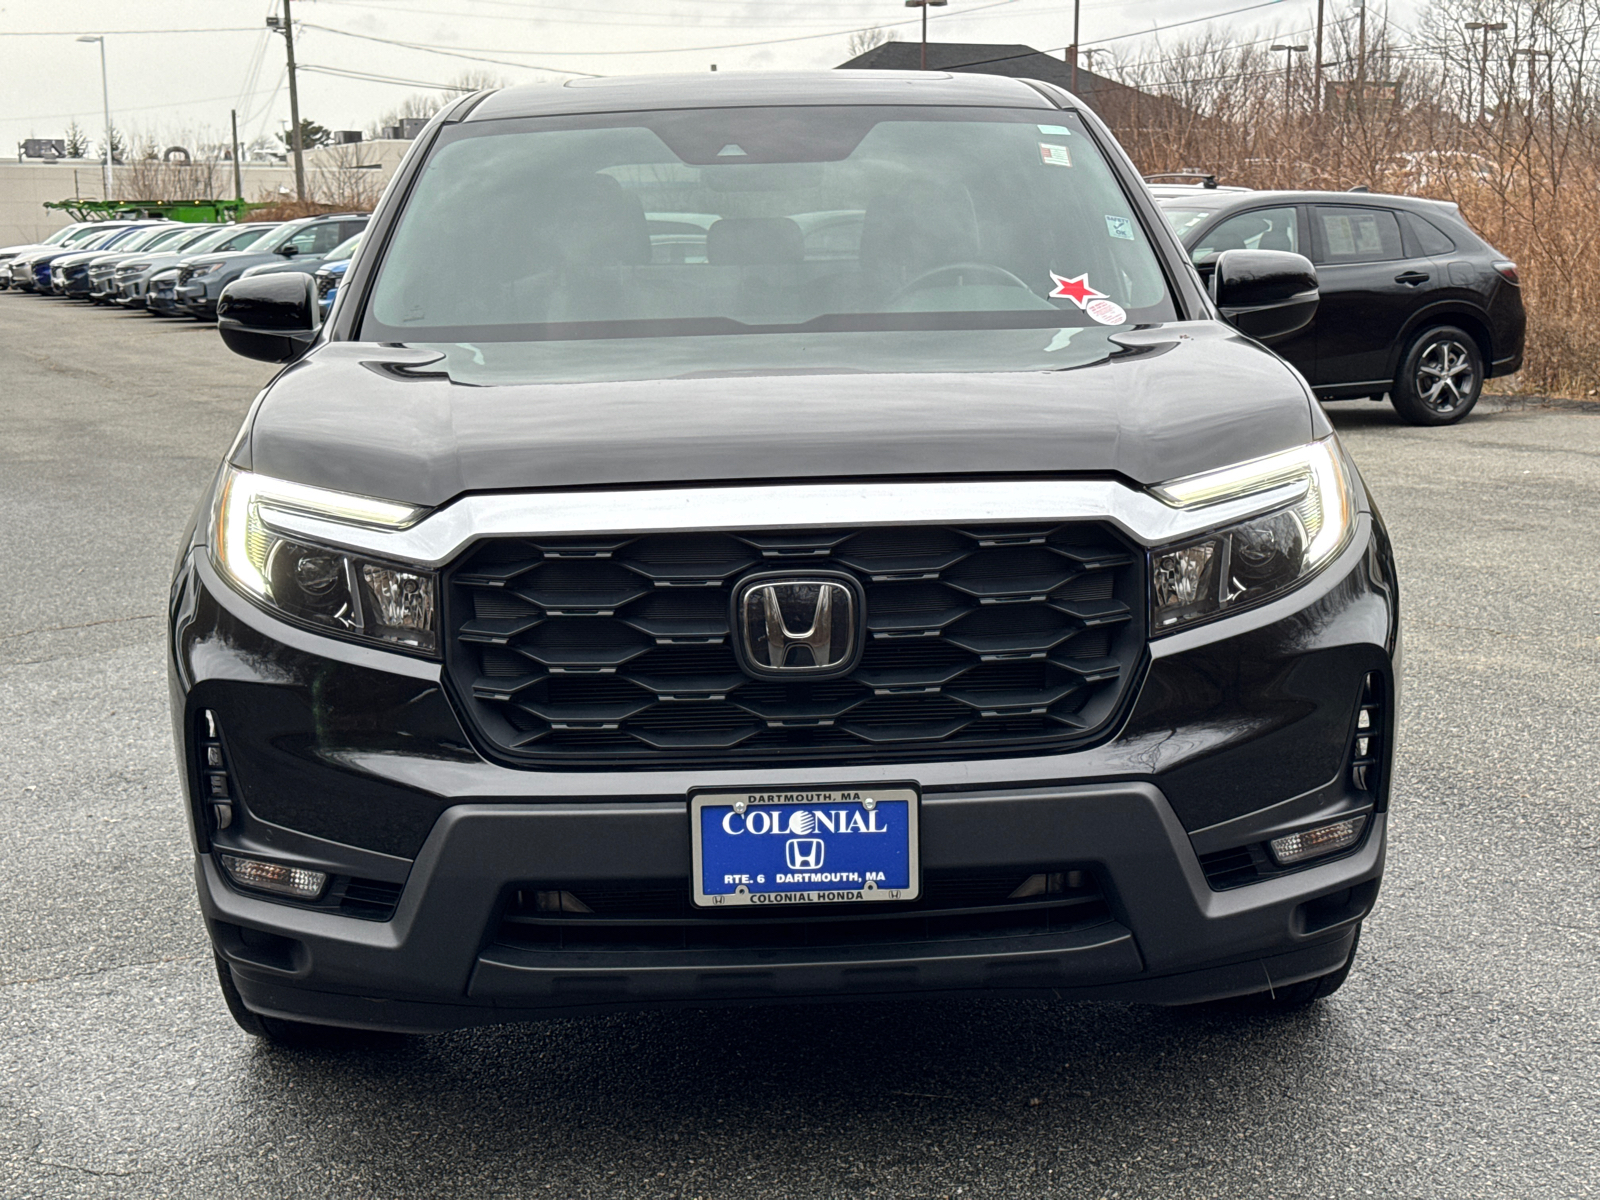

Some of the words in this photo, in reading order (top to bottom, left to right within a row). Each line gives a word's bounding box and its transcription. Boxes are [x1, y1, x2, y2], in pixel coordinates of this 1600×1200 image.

[748, 793, 837, 803] DARTMOUTH,
[841, 793, 861, 801] MA
[722, 810, 888, 835] COLONIAL
[724, 874, 754, 884] RTE.
[756, 874, 766, 884] 6
[776, 872, 862, 883] DARTMOUTH,
[865, 871, 886, 881] MA
[749, 892, 814, 904] COLONIAL
[817, 891, 864, 901] HONDA
